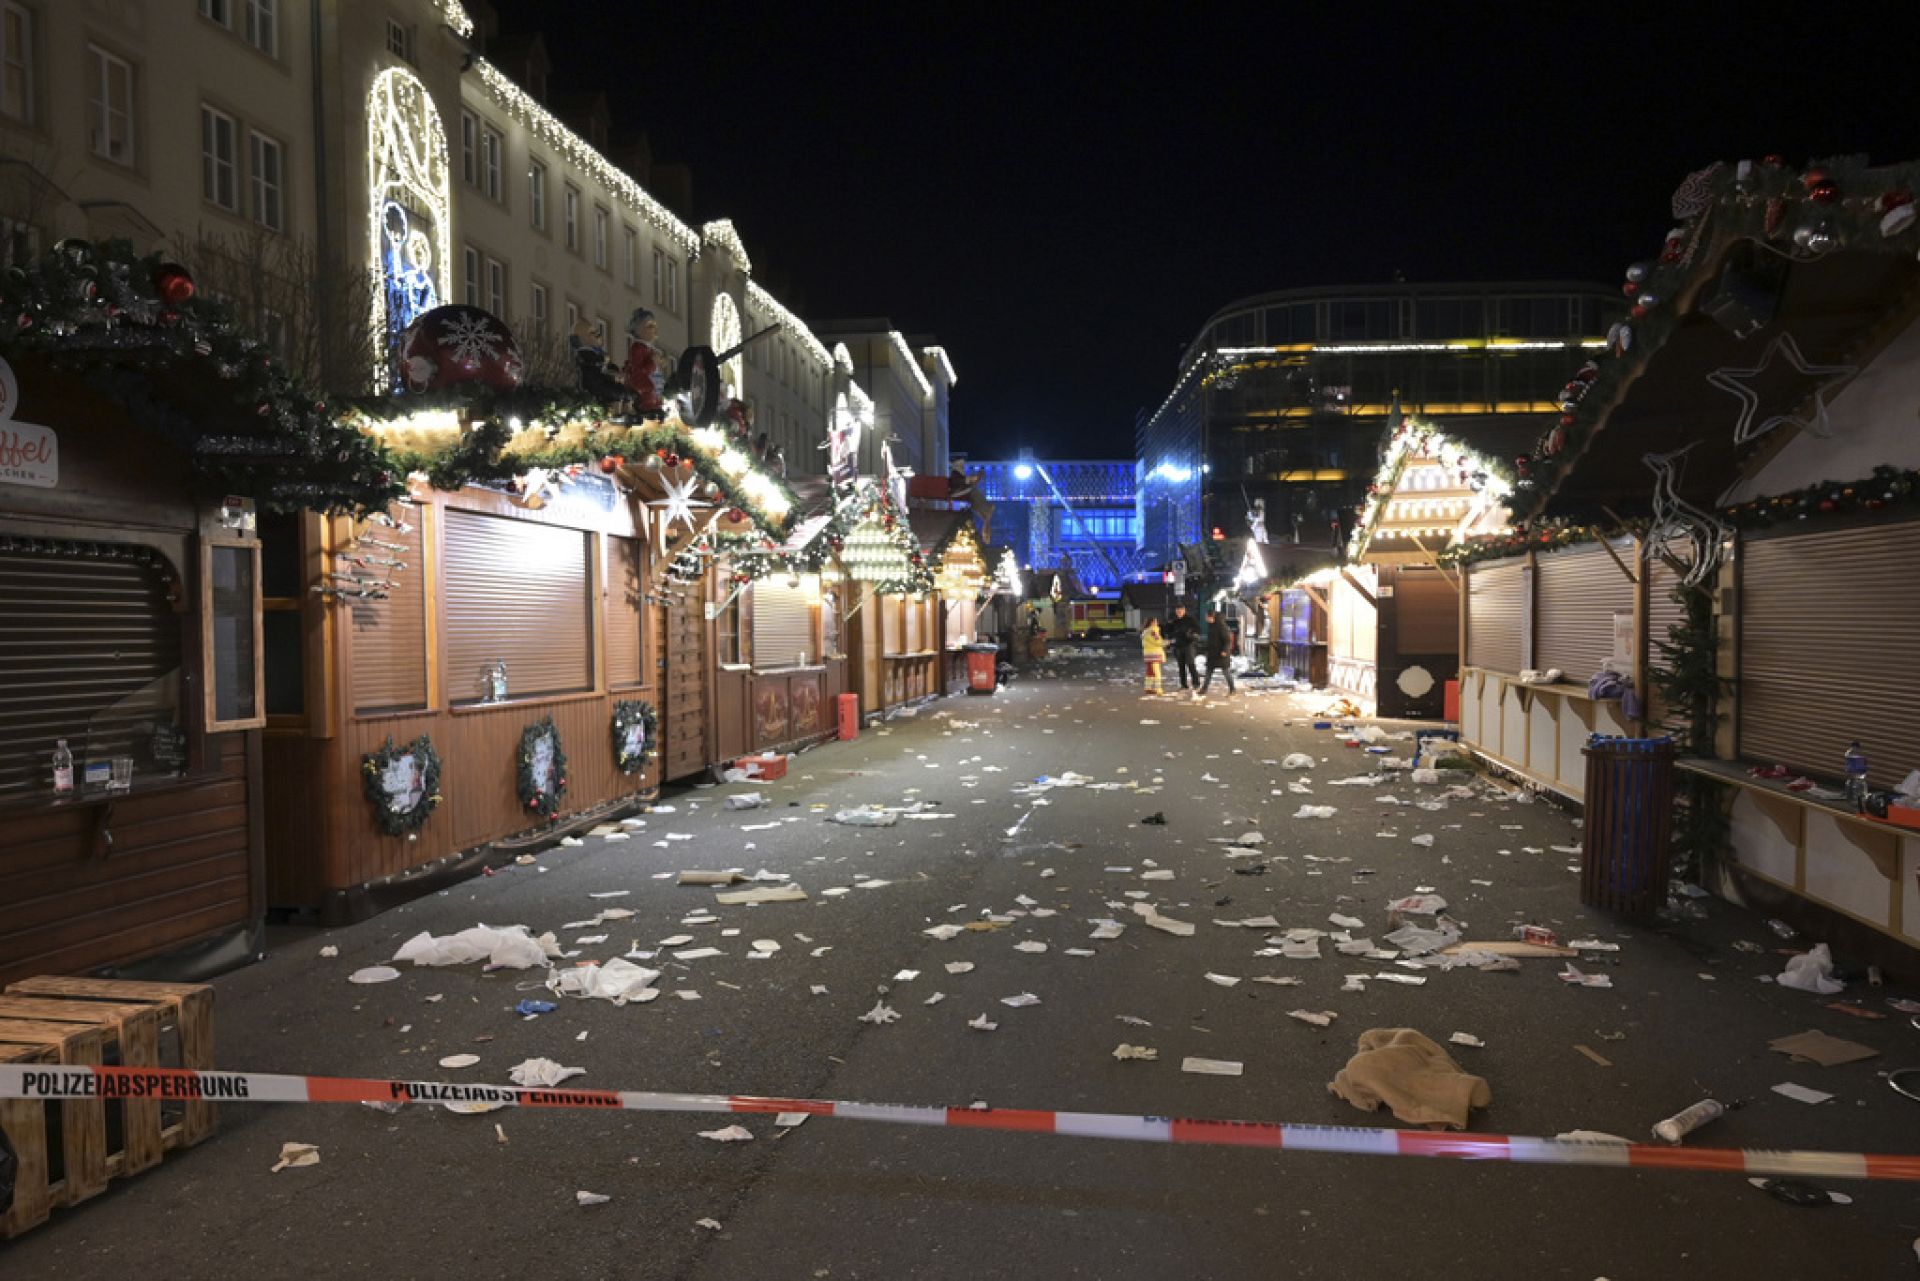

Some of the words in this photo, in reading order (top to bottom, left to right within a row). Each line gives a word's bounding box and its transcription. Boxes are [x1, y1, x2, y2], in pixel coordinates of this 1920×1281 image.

[0, 430, 52, 468] ffel
[0, 468, 35, 480] CHEN
[22, 1072, 249, 1098] POLIZEIABSPERRUNG
